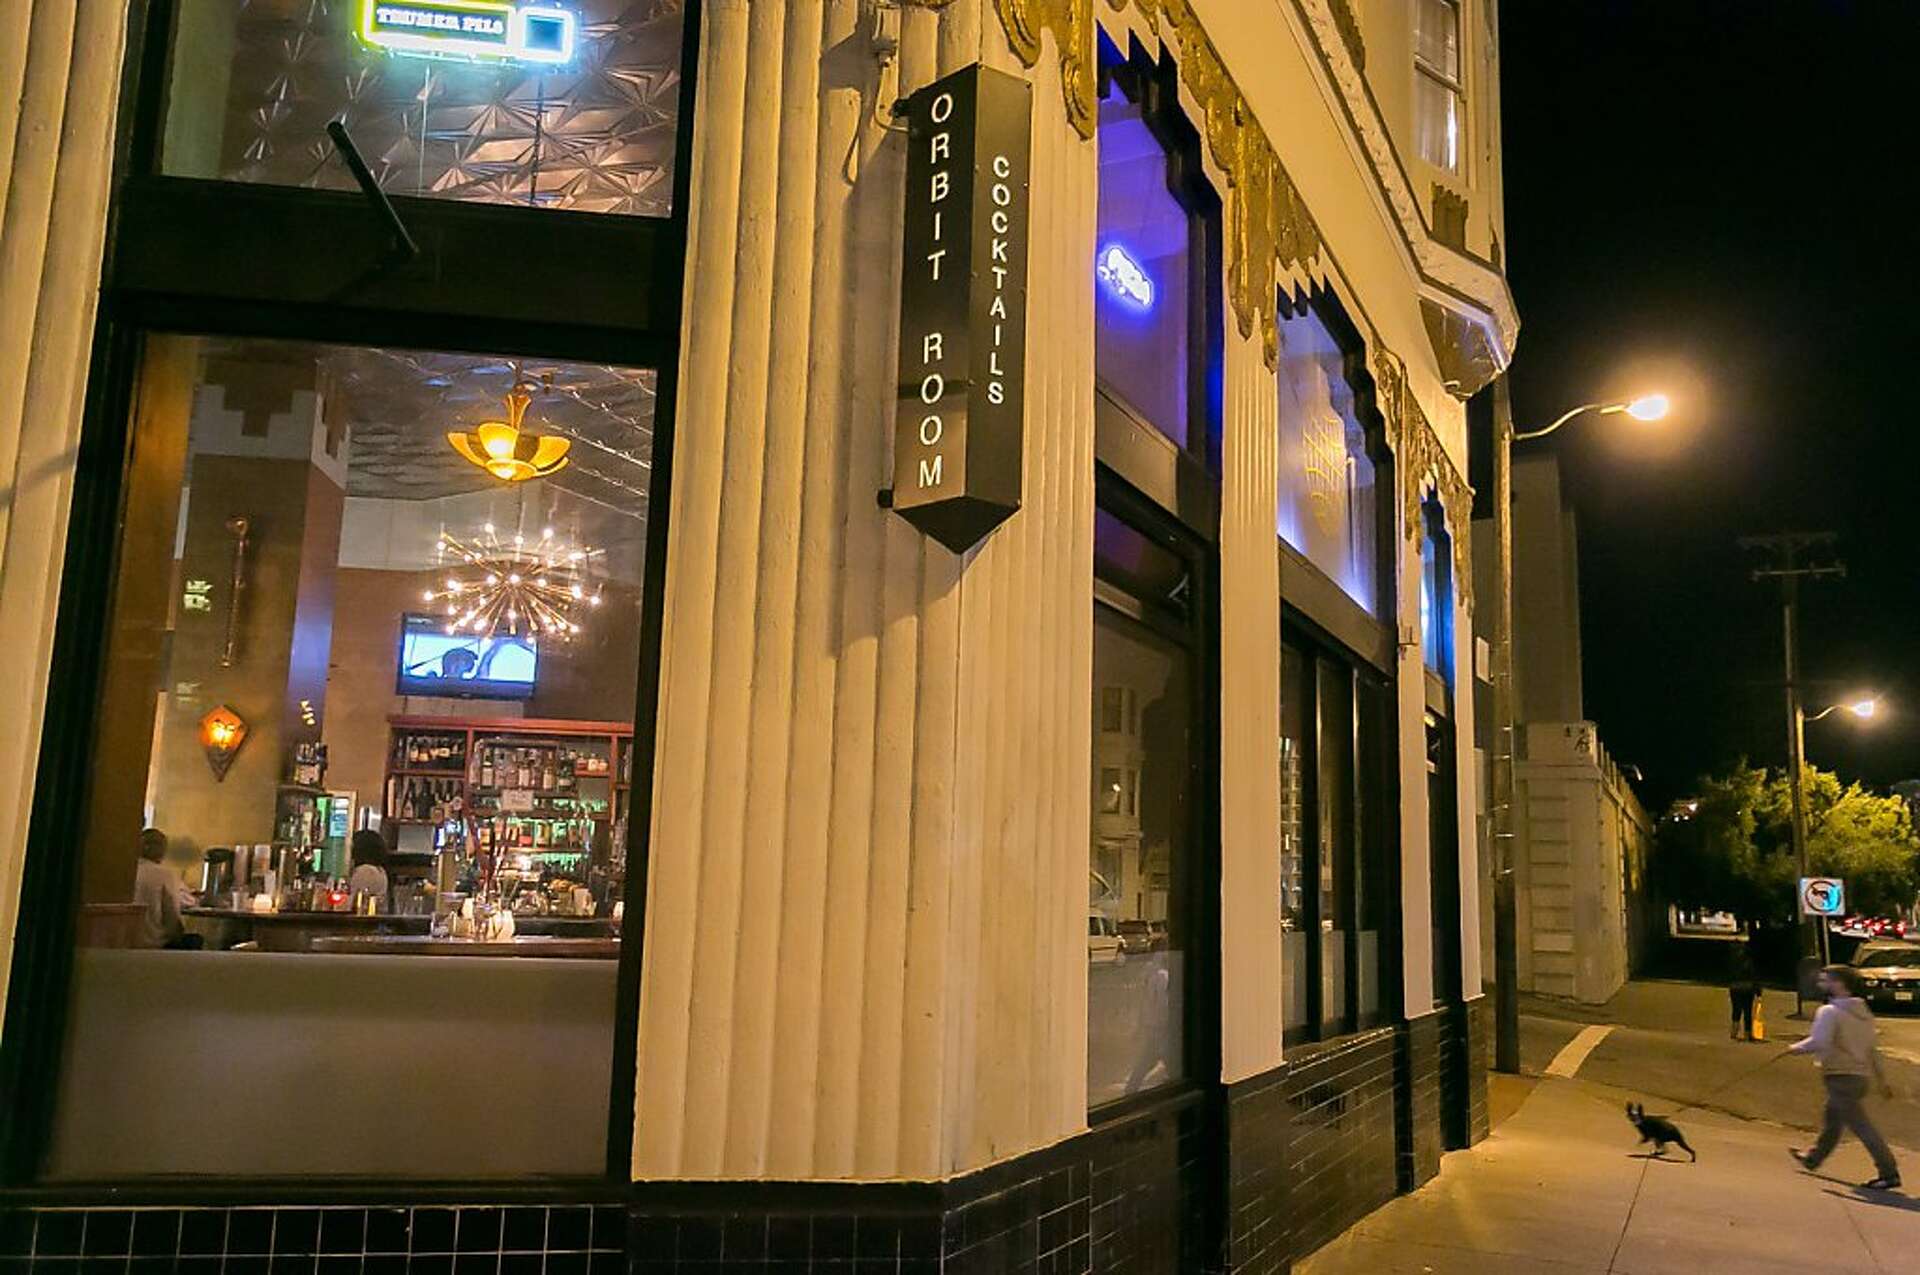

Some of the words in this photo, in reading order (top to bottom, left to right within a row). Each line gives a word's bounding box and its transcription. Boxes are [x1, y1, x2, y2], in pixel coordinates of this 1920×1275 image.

[926, 92, 953, 281] ORBIT
[987, 155, 1012, 405] COCKTAILS
[918, 332, 945, 489] ROOM
